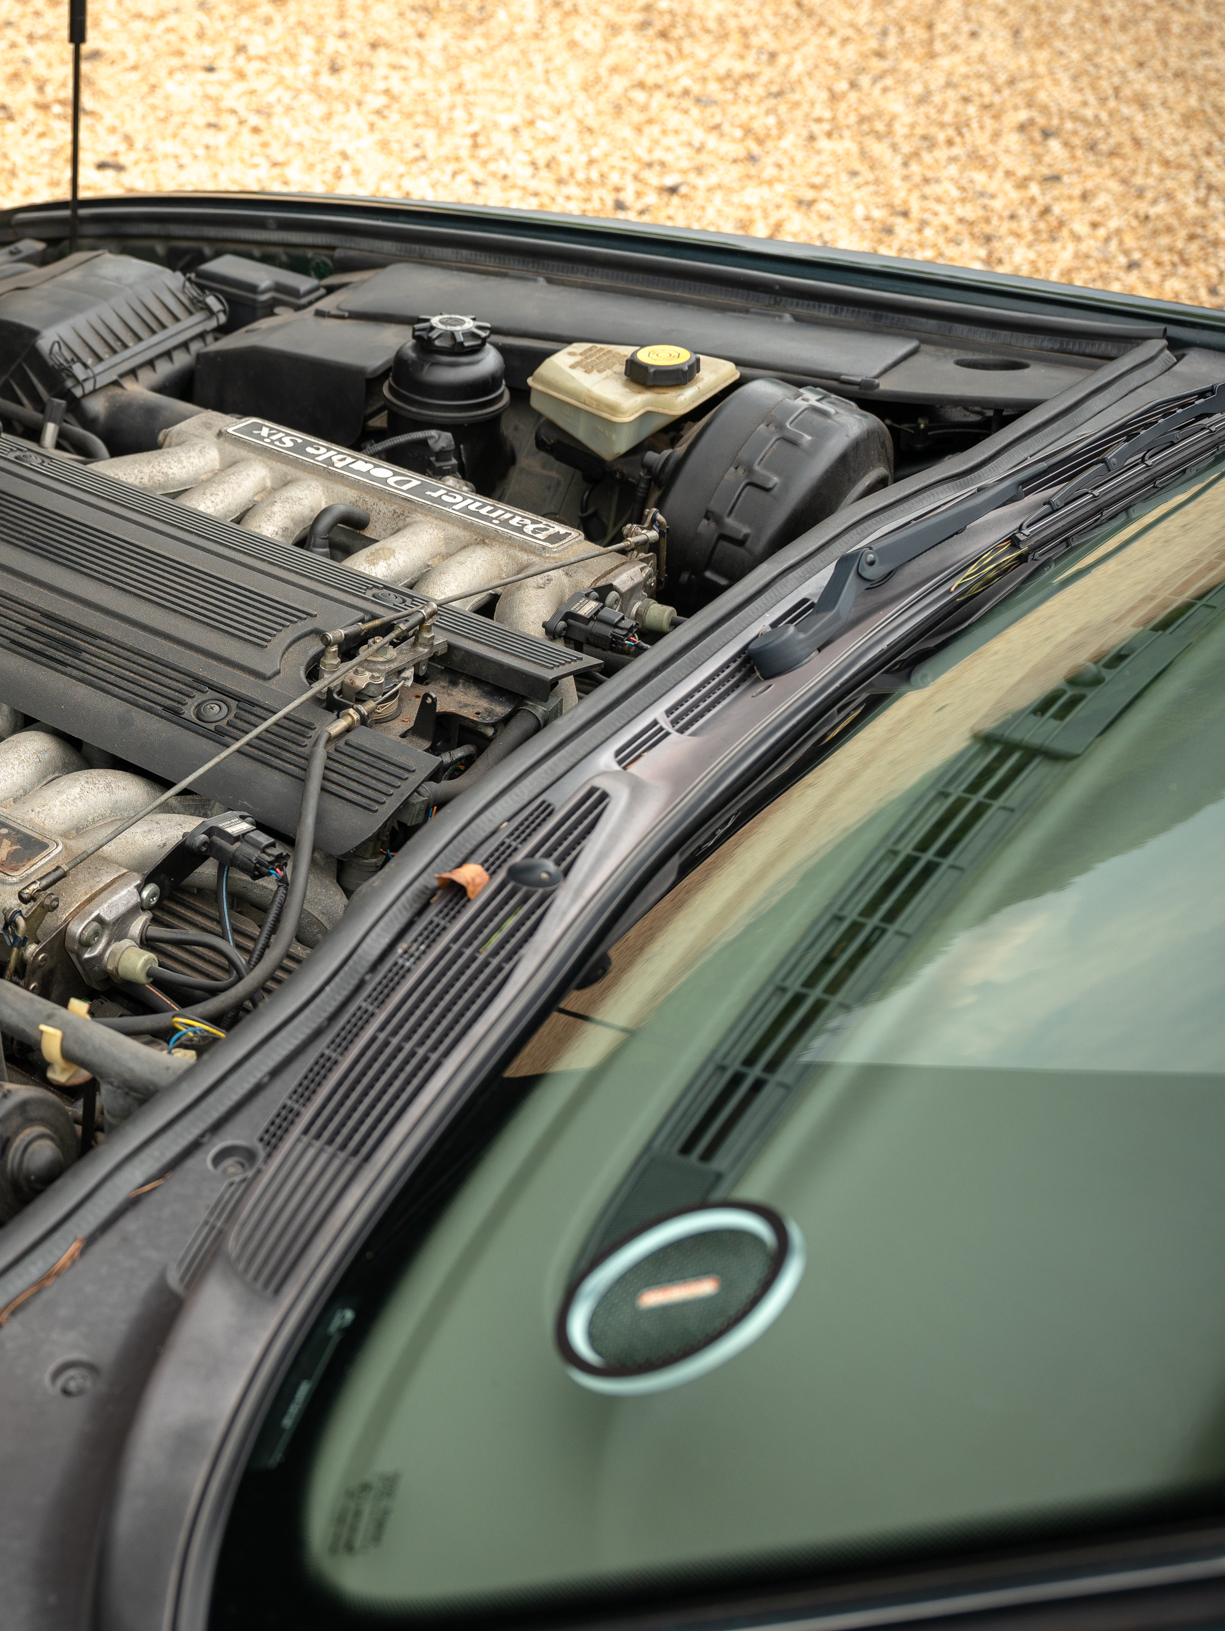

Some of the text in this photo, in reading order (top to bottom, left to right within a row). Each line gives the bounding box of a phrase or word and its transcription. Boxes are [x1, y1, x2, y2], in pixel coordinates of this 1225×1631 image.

[252, 426, 557, 540] Daimler Double Six
